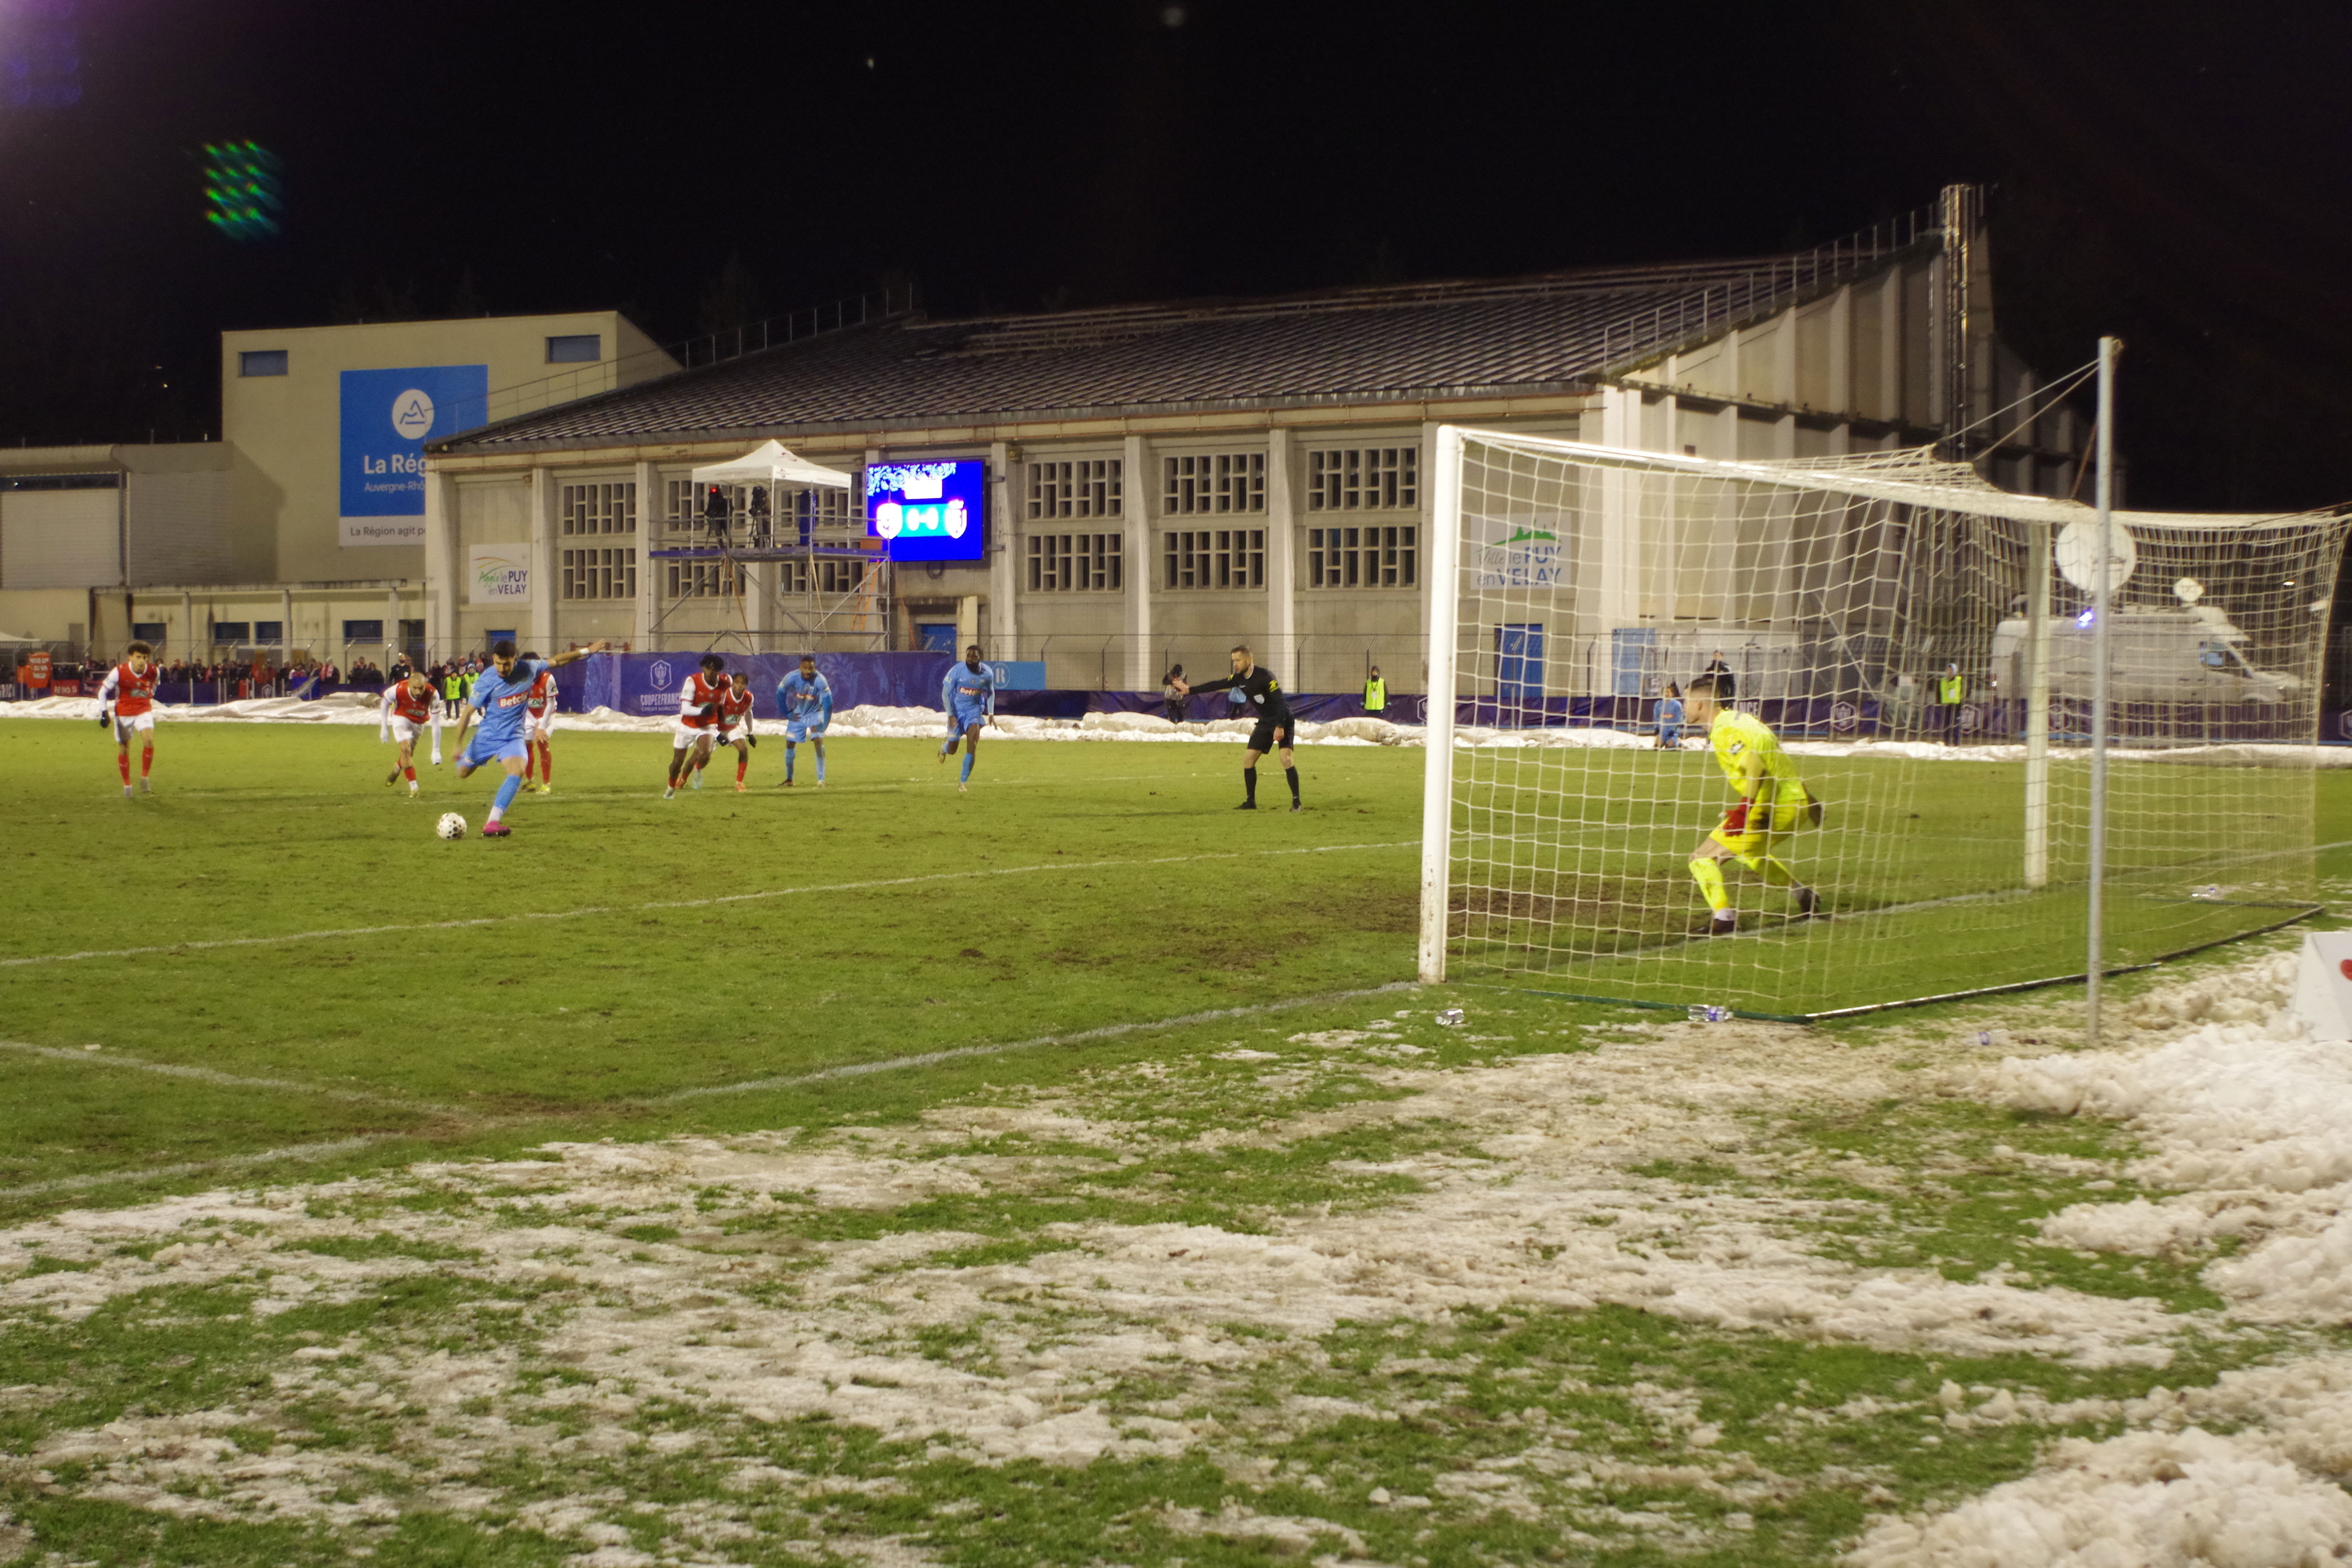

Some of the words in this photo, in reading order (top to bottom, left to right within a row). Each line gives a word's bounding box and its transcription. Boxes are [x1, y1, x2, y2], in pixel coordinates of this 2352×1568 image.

[364, 455, 386, 474] La
[351, 527, 361, 536] La
[363, 526, 395, 537] Région
[398, 526, 415, 537] agit
[1525, 546, 1561, 564] PUY
[508, 570, 527, 582] PUY
[1477, 574, 1495, 586] en
[1497, 568, 1562, 585] VELAY
[498, 584, 527, 594] VELAY
